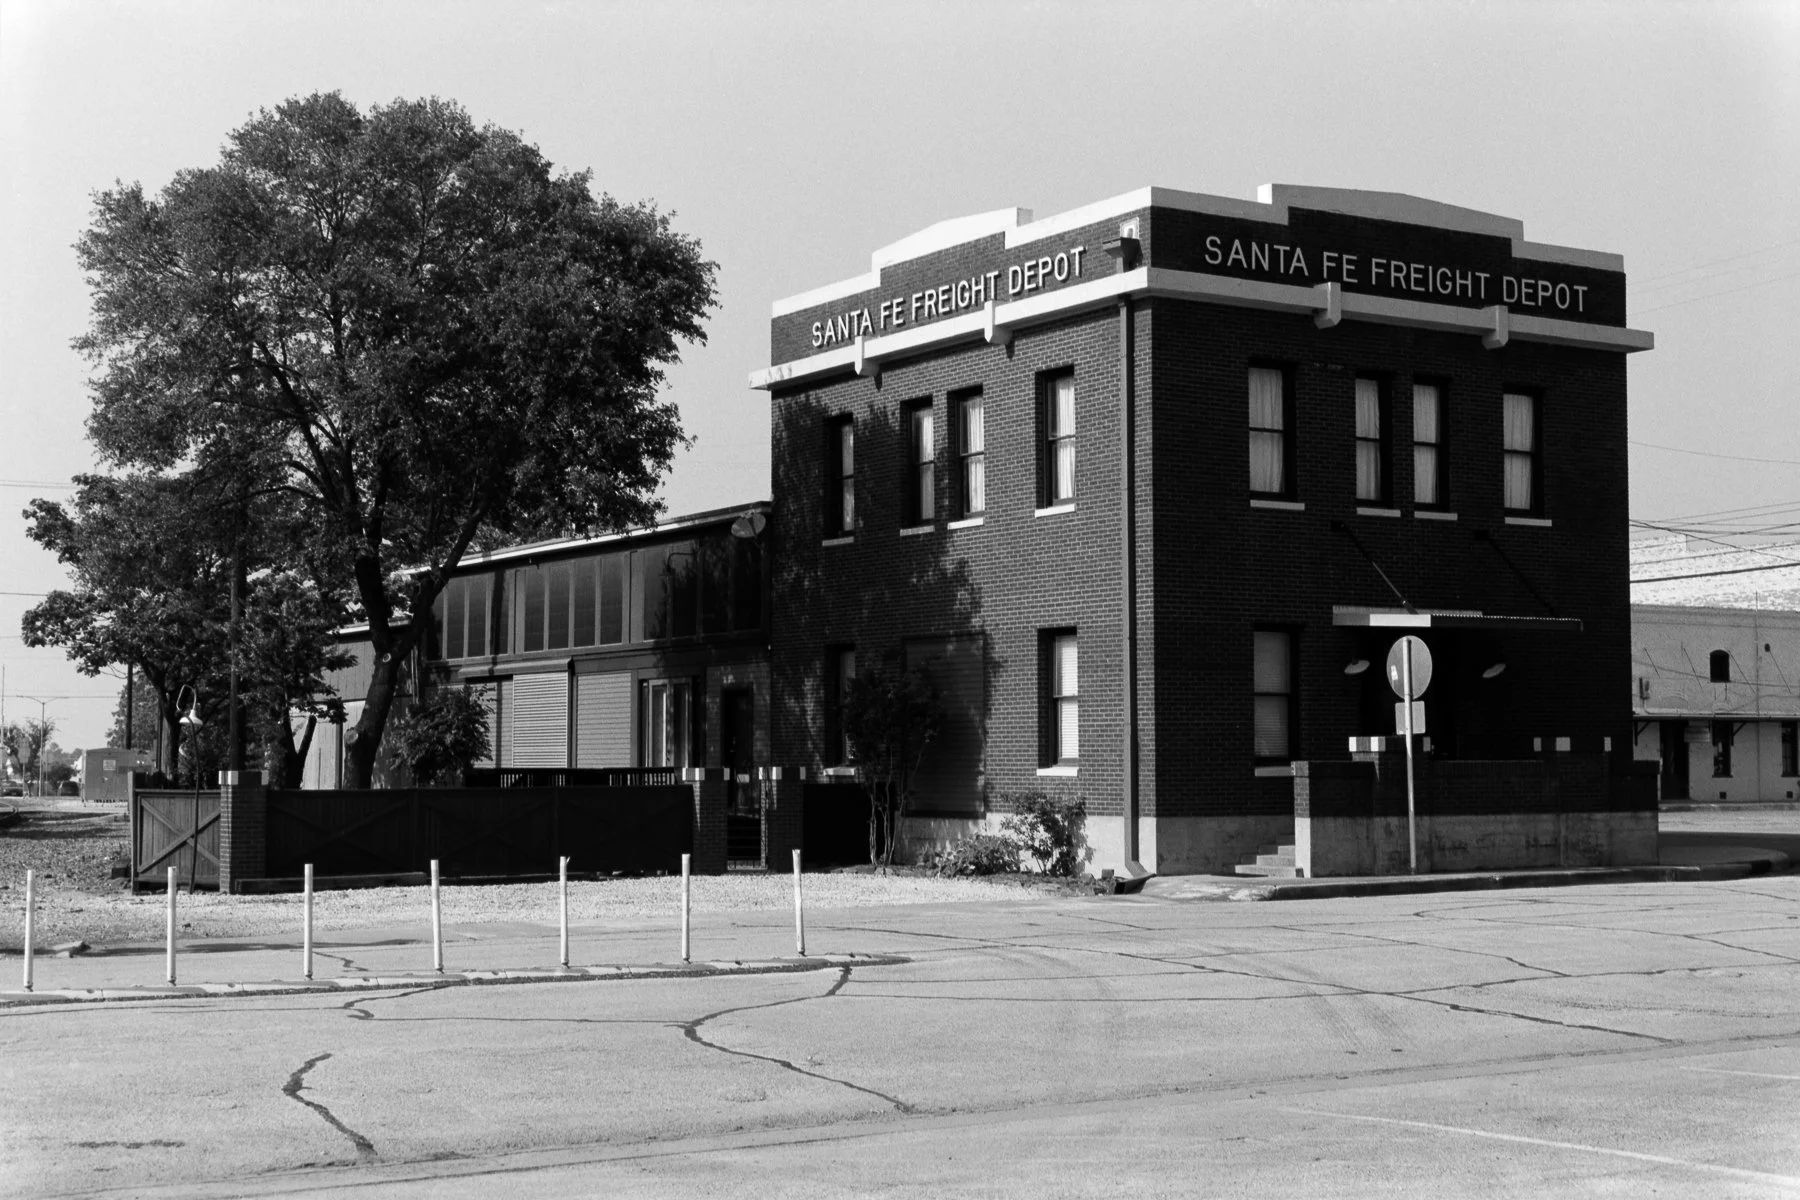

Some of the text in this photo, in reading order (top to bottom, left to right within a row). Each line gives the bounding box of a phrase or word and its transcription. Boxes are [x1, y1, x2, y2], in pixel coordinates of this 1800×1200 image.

[811, 247, 1084, 348] SANTA FE FREIGHT DEPOT
[1204, 236, 1588, 312] SANTA FE FREIGHT DEPOT
